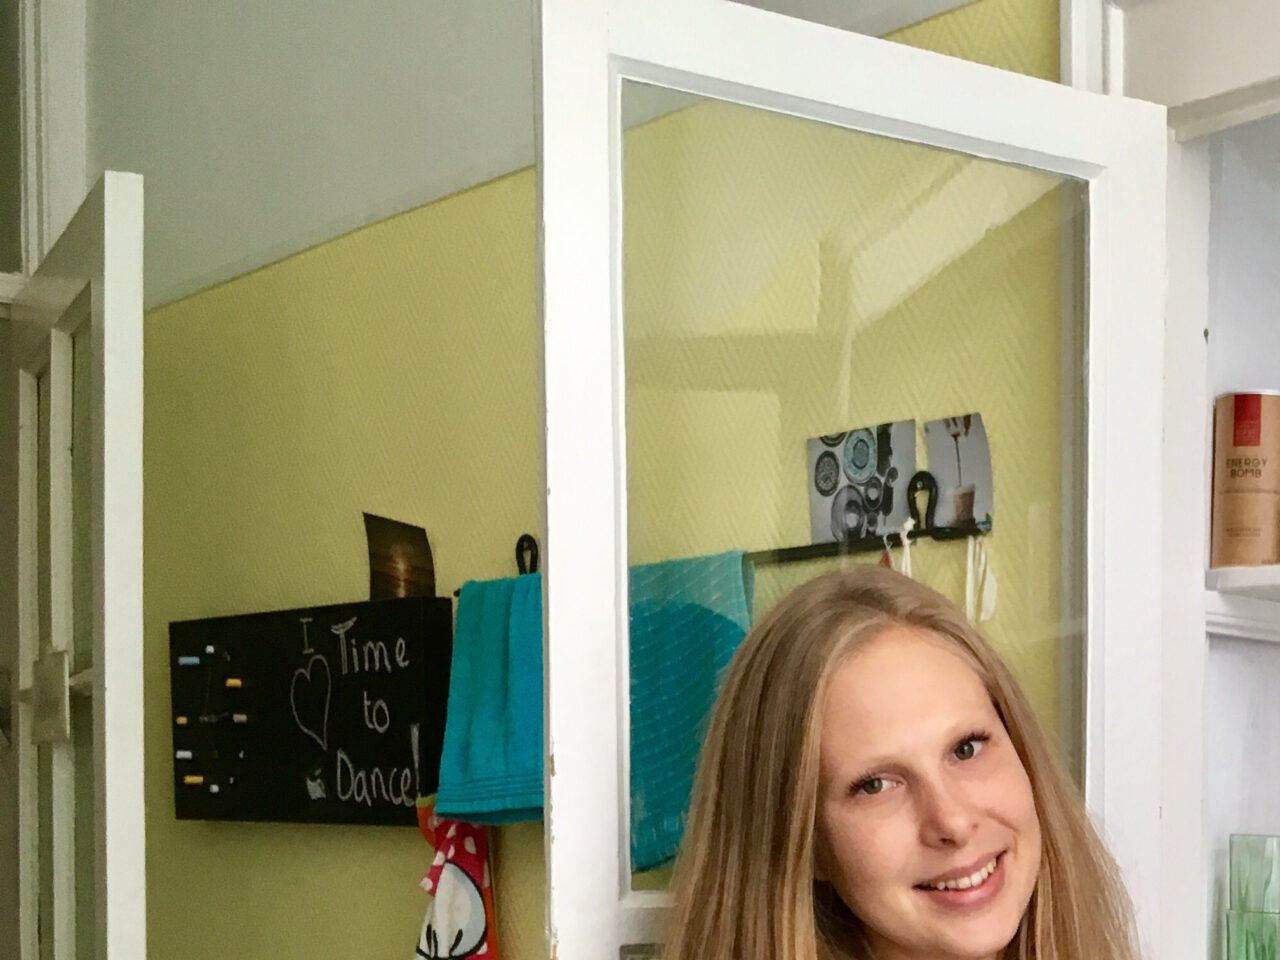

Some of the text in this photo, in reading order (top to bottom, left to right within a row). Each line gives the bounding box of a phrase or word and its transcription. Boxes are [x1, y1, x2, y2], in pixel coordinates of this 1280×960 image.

[1226, 458, 1267, 468] ENERGY
[1230, 469, 1262, 479] BOMB
[331, 616, 410, 675] Time
[363, 690, 390, 733] to
